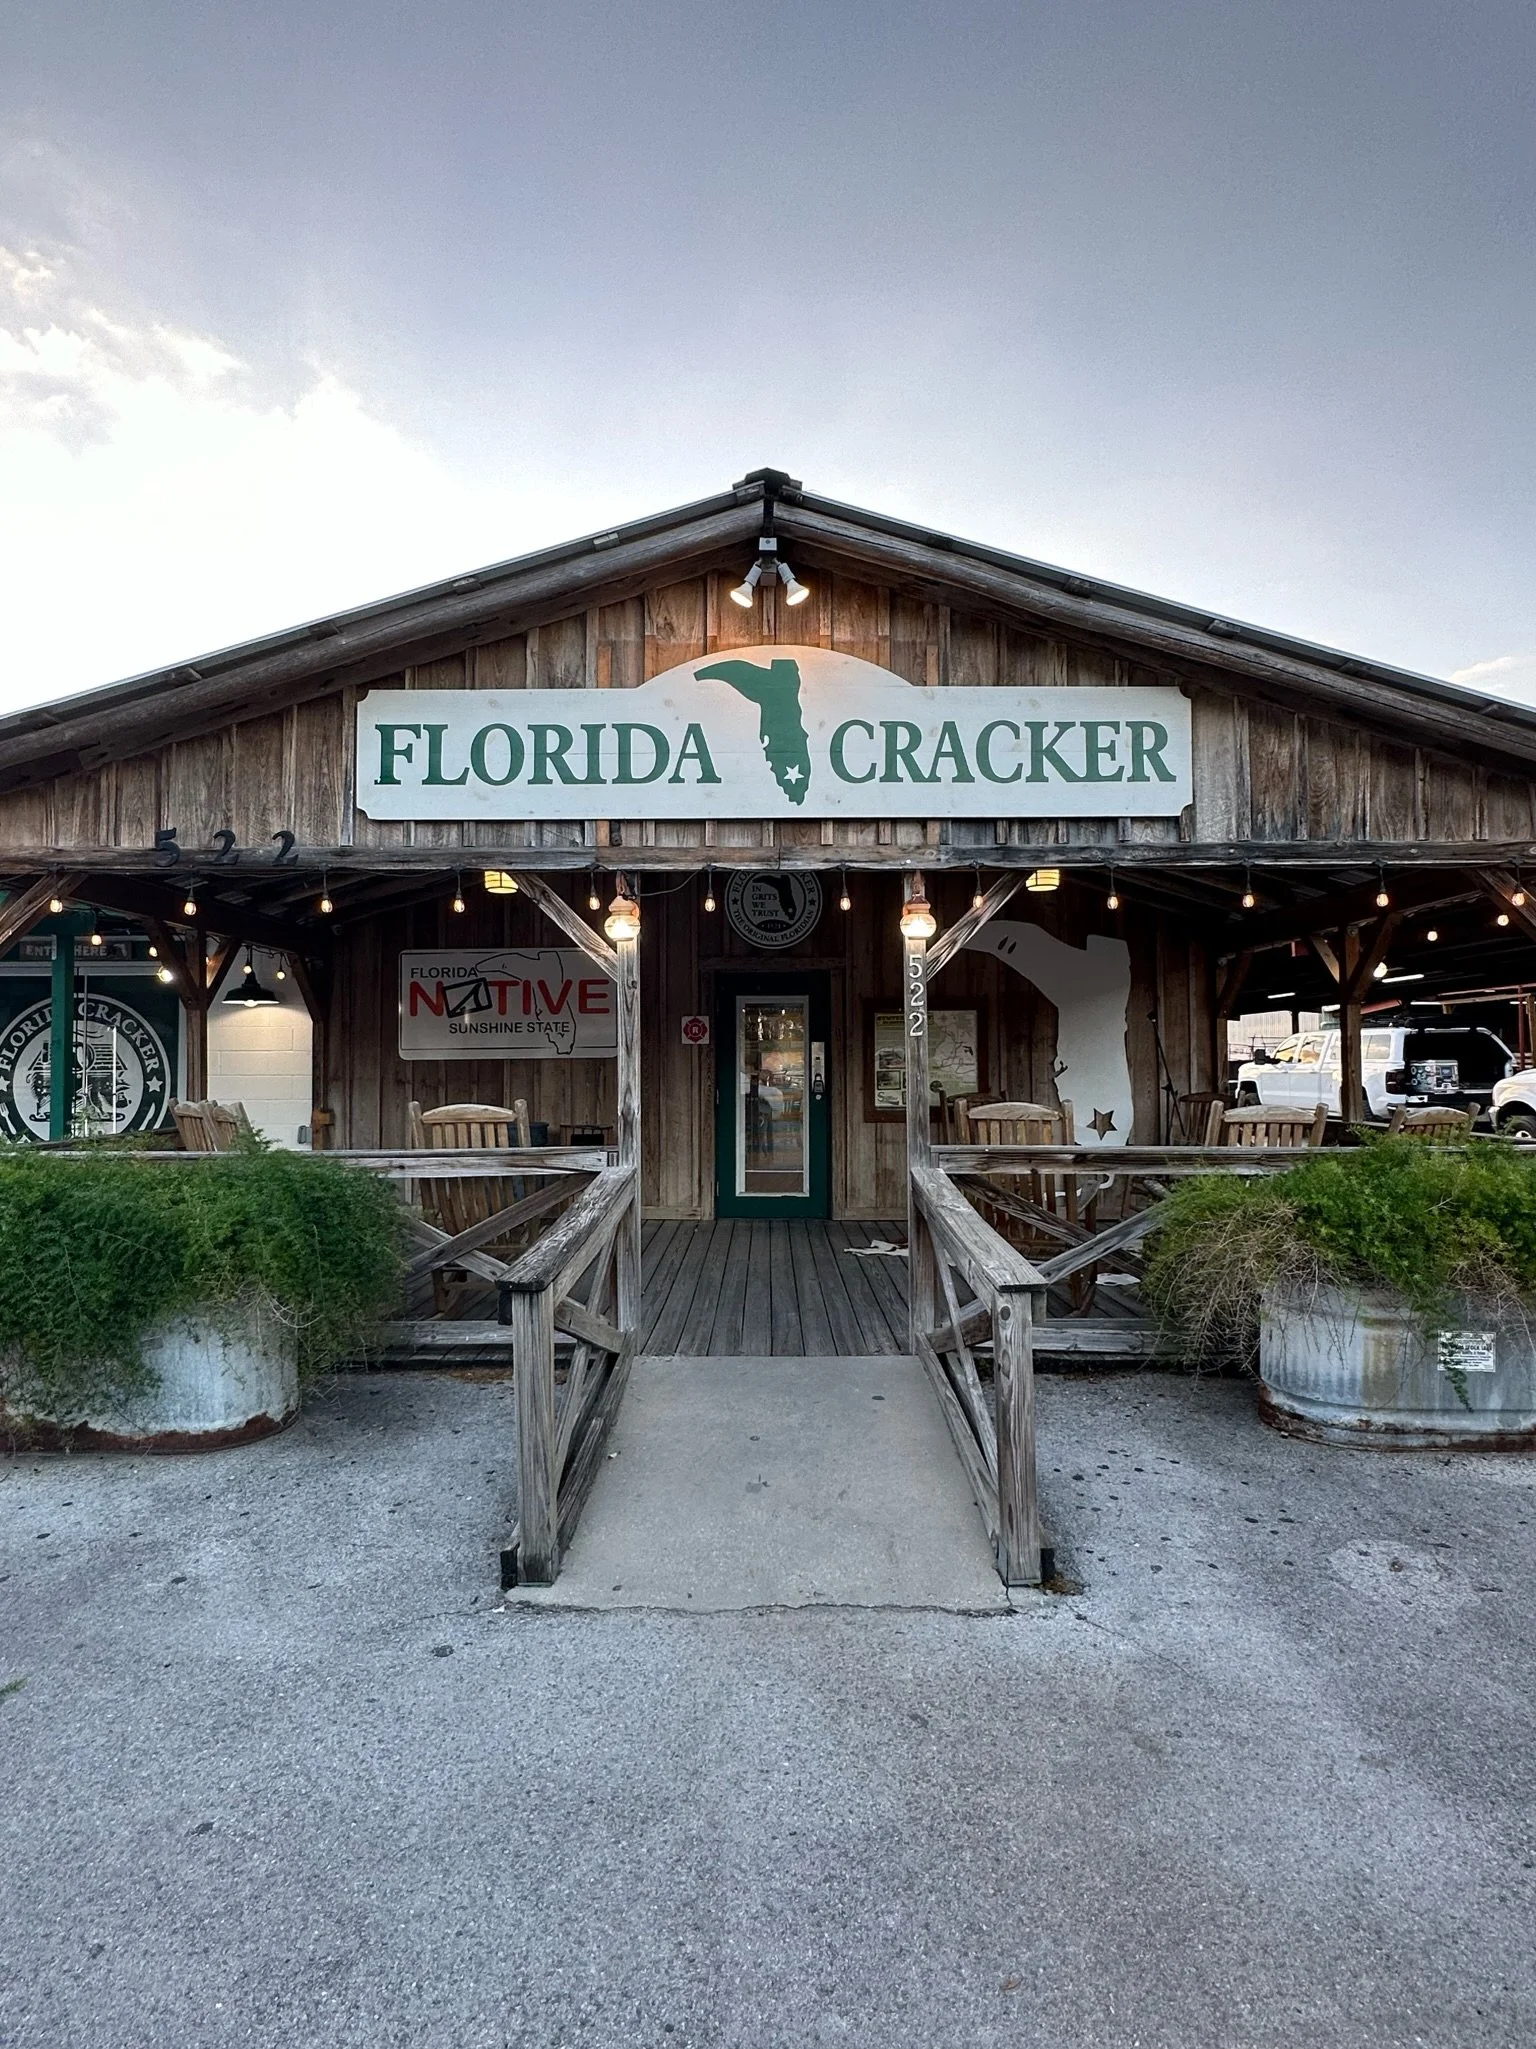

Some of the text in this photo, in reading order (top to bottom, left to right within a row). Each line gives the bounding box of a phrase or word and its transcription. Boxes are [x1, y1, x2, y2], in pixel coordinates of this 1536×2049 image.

[374, 720, 1177, 785] FLORIDA CRACKER
[155, 827, 299, 867] 522
[752, 893, 778, 901] GRITS
[743, 924, 779, 942] ORIGINAL
[74, 944, 107, 957] HERE
[410, 966, 478, 979] FLORIDA
[409, 976, 610, 1018] NATIVE
[909, 955, 925, 1036] 522
[78, 1002, 160, 1073] CRACKER
[449, 1021, 570, 1034] SUNSHINE STATE
